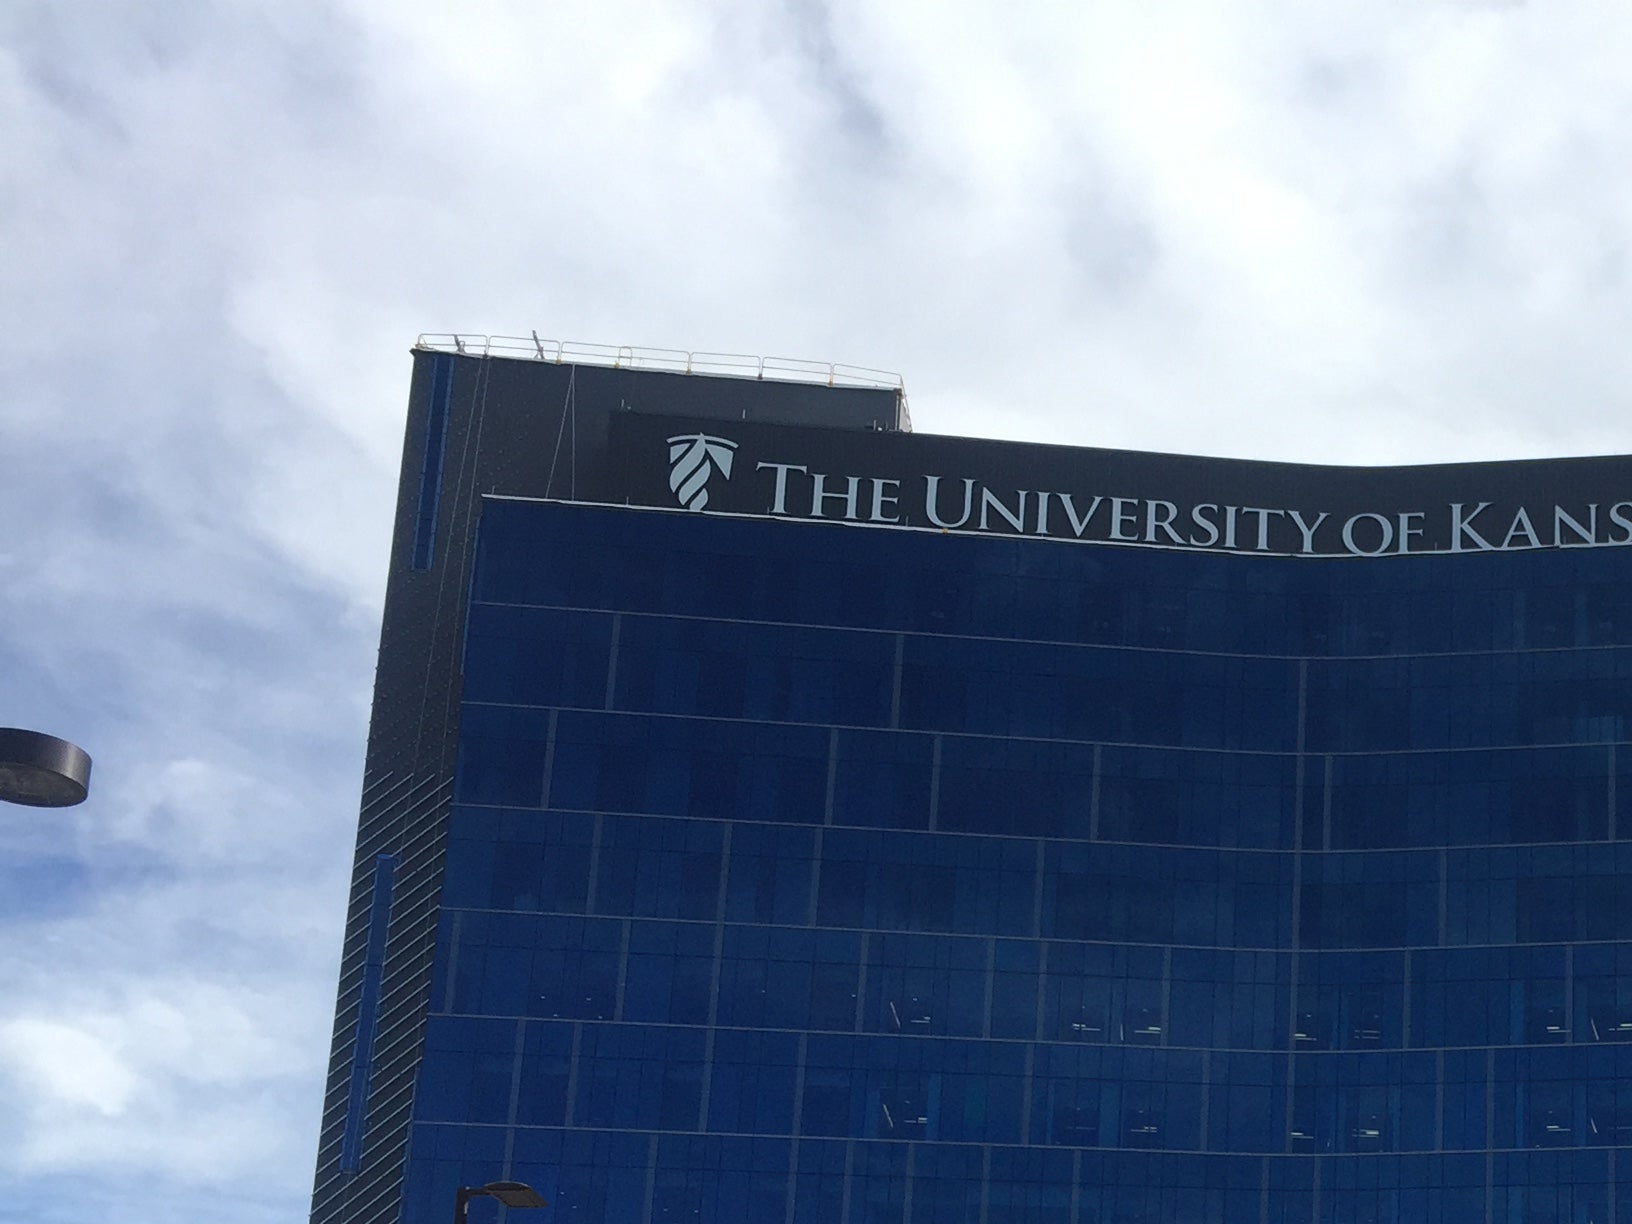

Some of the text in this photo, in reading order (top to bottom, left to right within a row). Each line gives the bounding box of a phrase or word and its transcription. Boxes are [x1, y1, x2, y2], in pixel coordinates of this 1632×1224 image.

[756, 461, 900, 524] THE
[924, 475, 1330, 554] UNIVERSITY
[1341, 511, 1425, 557] OF
